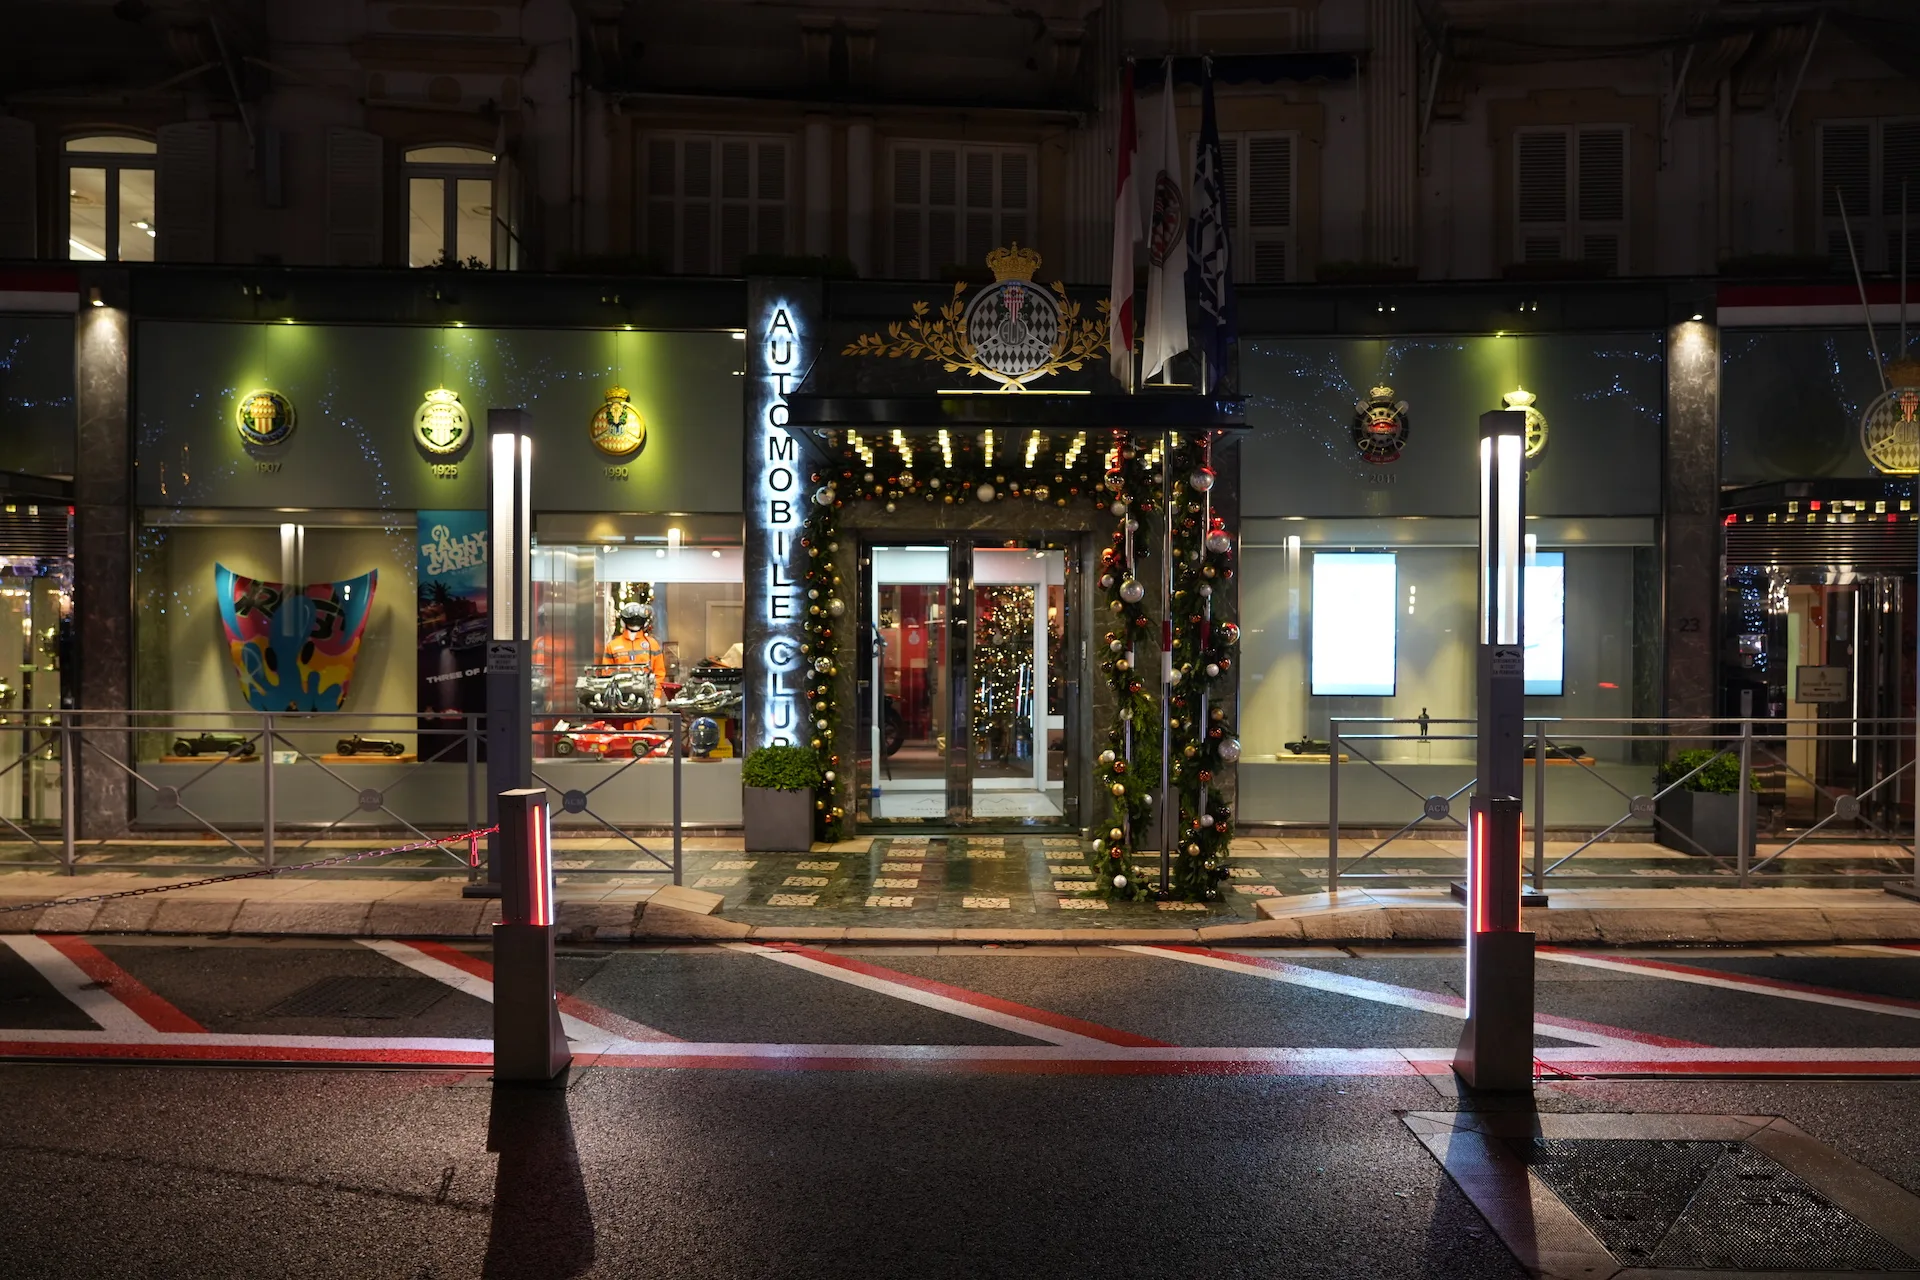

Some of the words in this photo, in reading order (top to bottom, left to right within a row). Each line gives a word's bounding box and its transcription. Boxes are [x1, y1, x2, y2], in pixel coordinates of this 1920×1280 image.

[255, 462, 281, 473] 1907
[769, 309, 793, 618] AUTOMOBILE
[431, 464, 458, 475] 1925
[604, 466, 629, 477] 1990
[421, 530, 487, 557] RALLY
[1680, 617, 1700, 632] 23
[426, 671, 463, 684] THREE
[465, 668, 480, 677] OF
[1428, 804, 1448, 813] ACM
[1633, 804, 1654, 812] ACM
